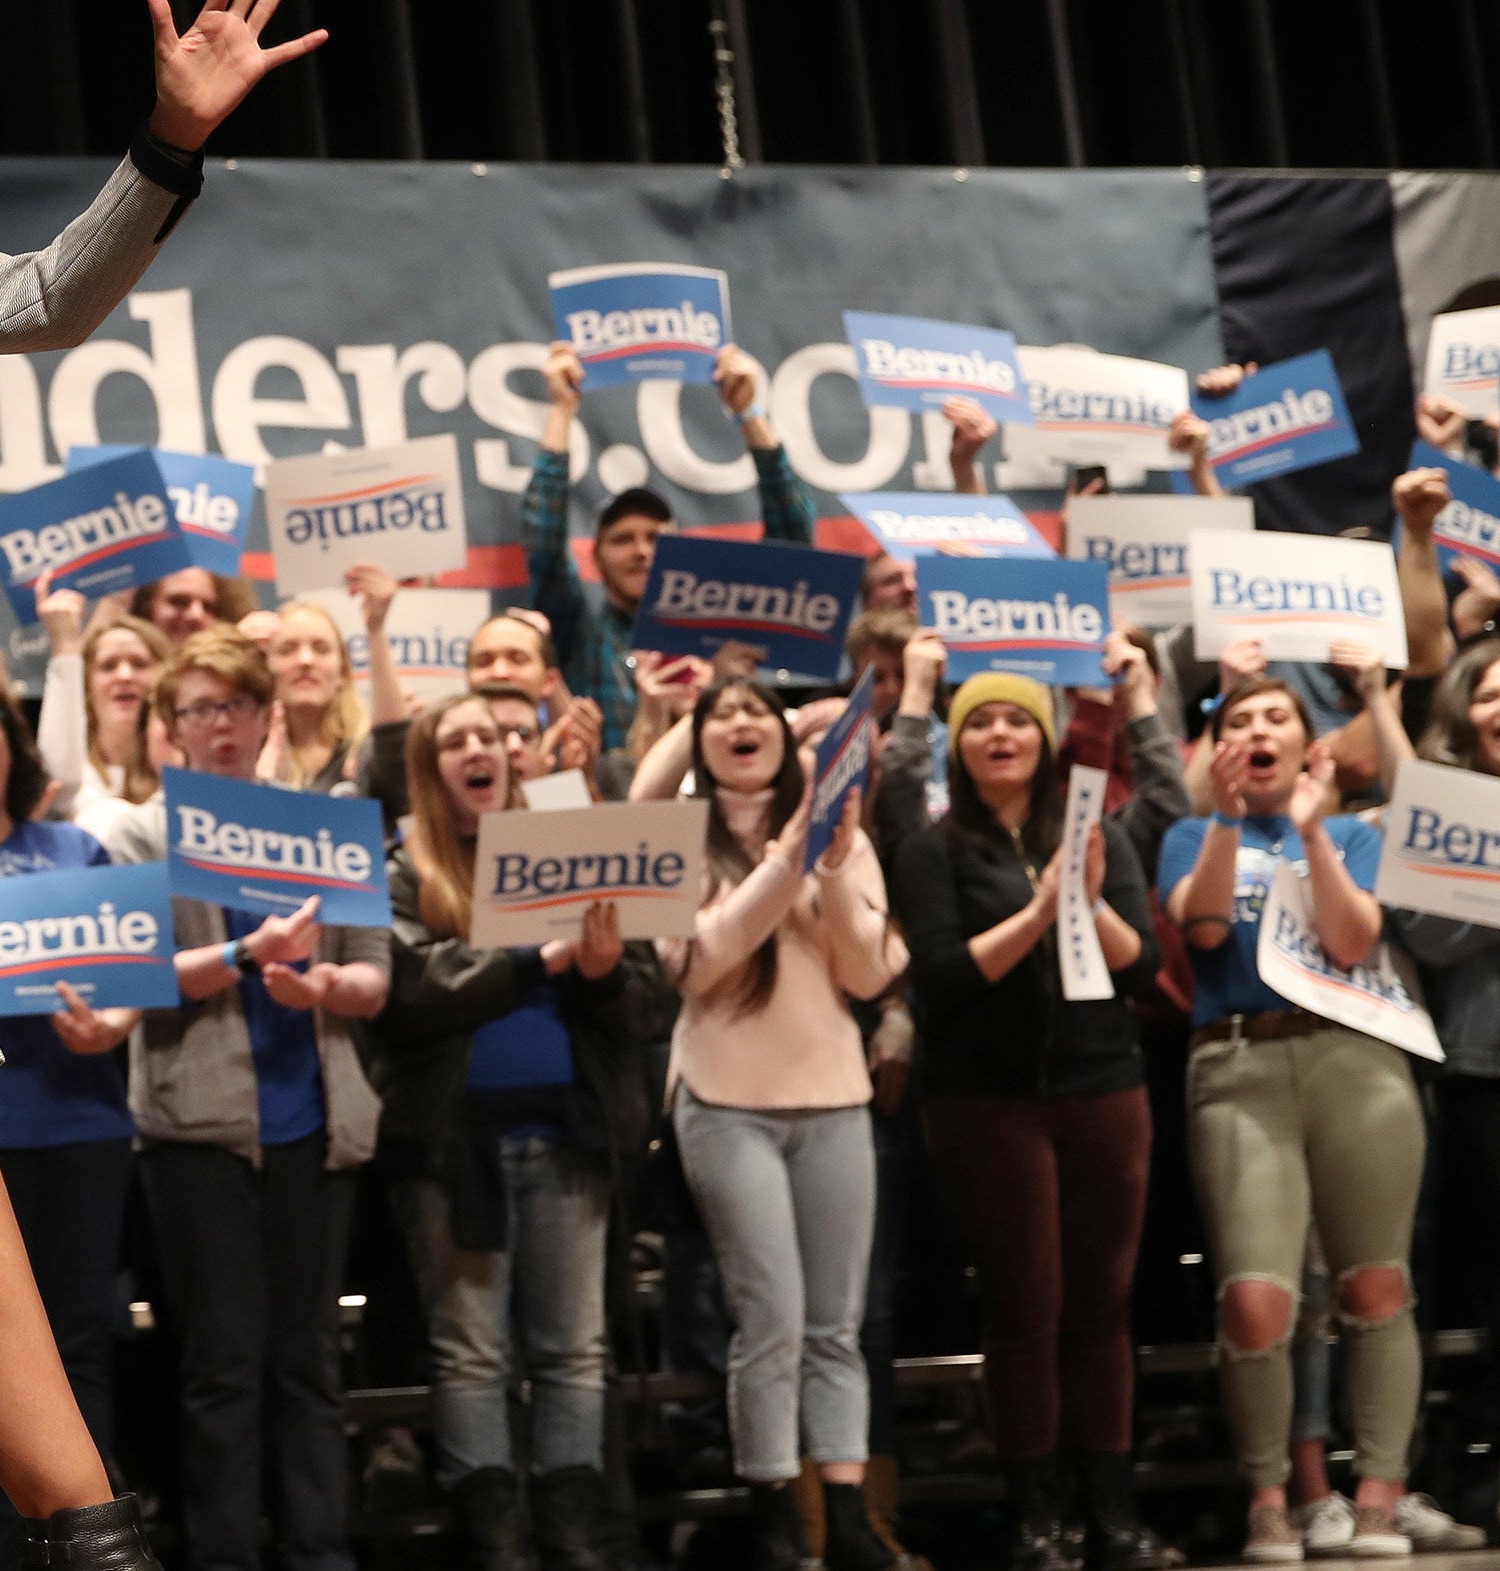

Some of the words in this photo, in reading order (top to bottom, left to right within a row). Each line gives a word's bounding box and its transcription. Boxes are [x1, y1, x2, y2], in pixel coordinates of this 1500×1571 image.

[567, 300, 722, 349] Bernie
[861, 338, 1016, 393] Bernie
[1206, 387, 1333, 453] ernie
[285, 491, 449, 551] Bernie
[867, 509, 1029, 546] Bernie
[652, 569, 840, 633] Bernie
[930, 590, 1103, 642] Bernie
[1209, 569, 1385, 618] Bernie
[177, 805, 372, 881] Bernie
[492, 842, 685, 895] Bernie
